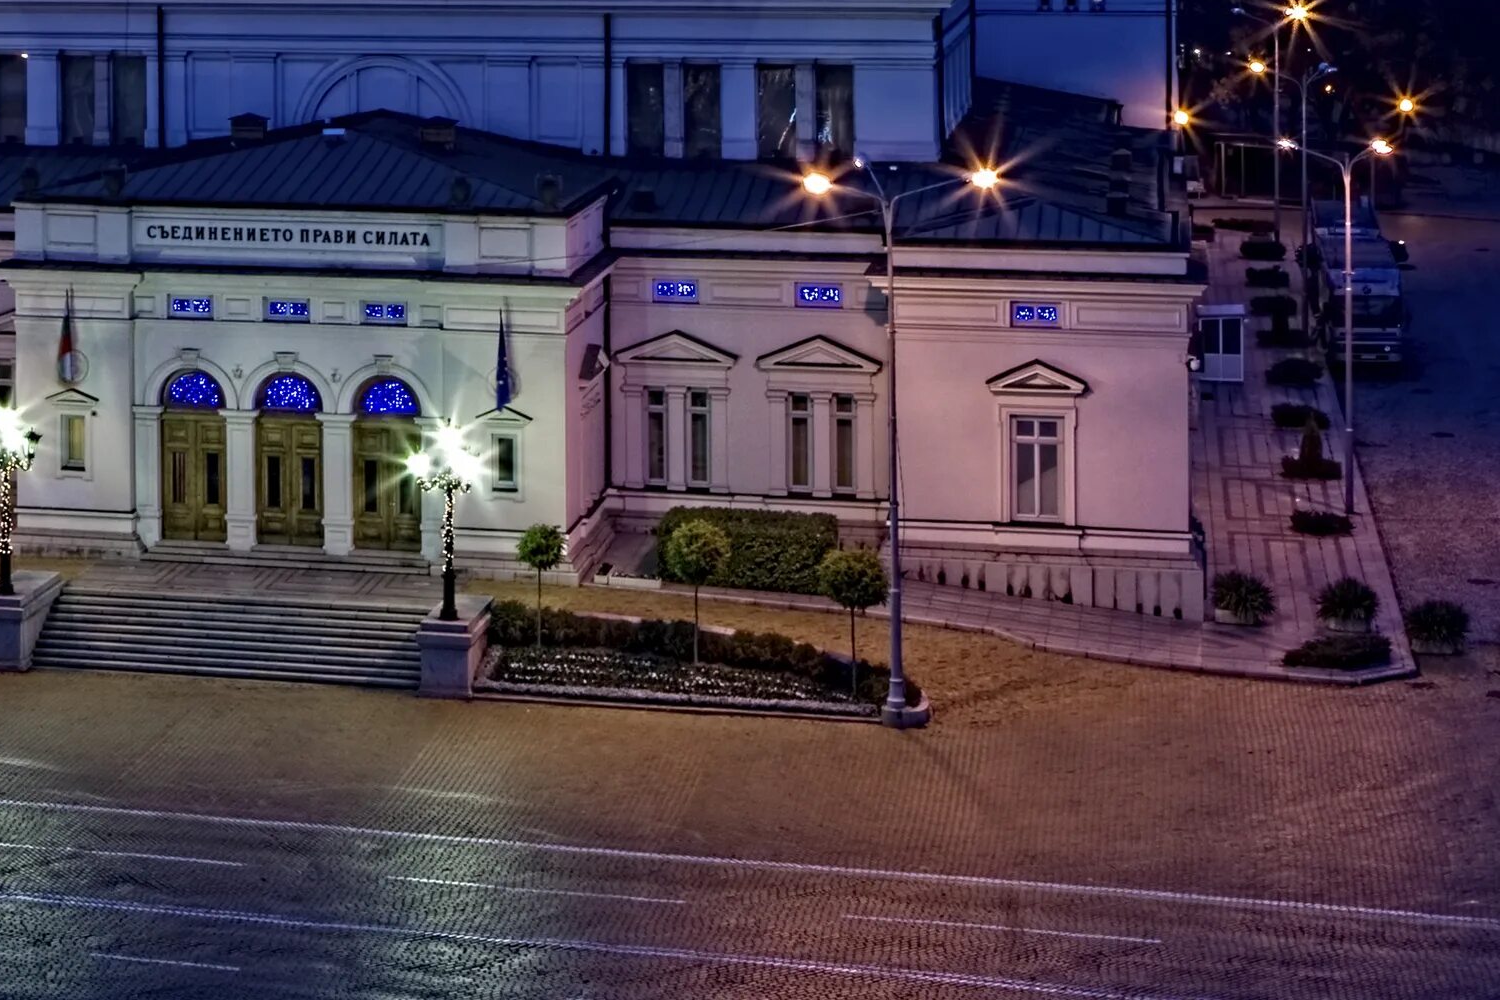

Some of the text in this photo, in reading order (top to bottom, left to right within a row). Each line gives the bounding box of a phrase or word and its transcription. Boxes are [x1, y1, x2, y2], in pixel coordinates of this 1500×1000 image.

[146, 225, 431, 248] СЪЕДИНЕНИЕТО ПРАВИ СИЛАТА
